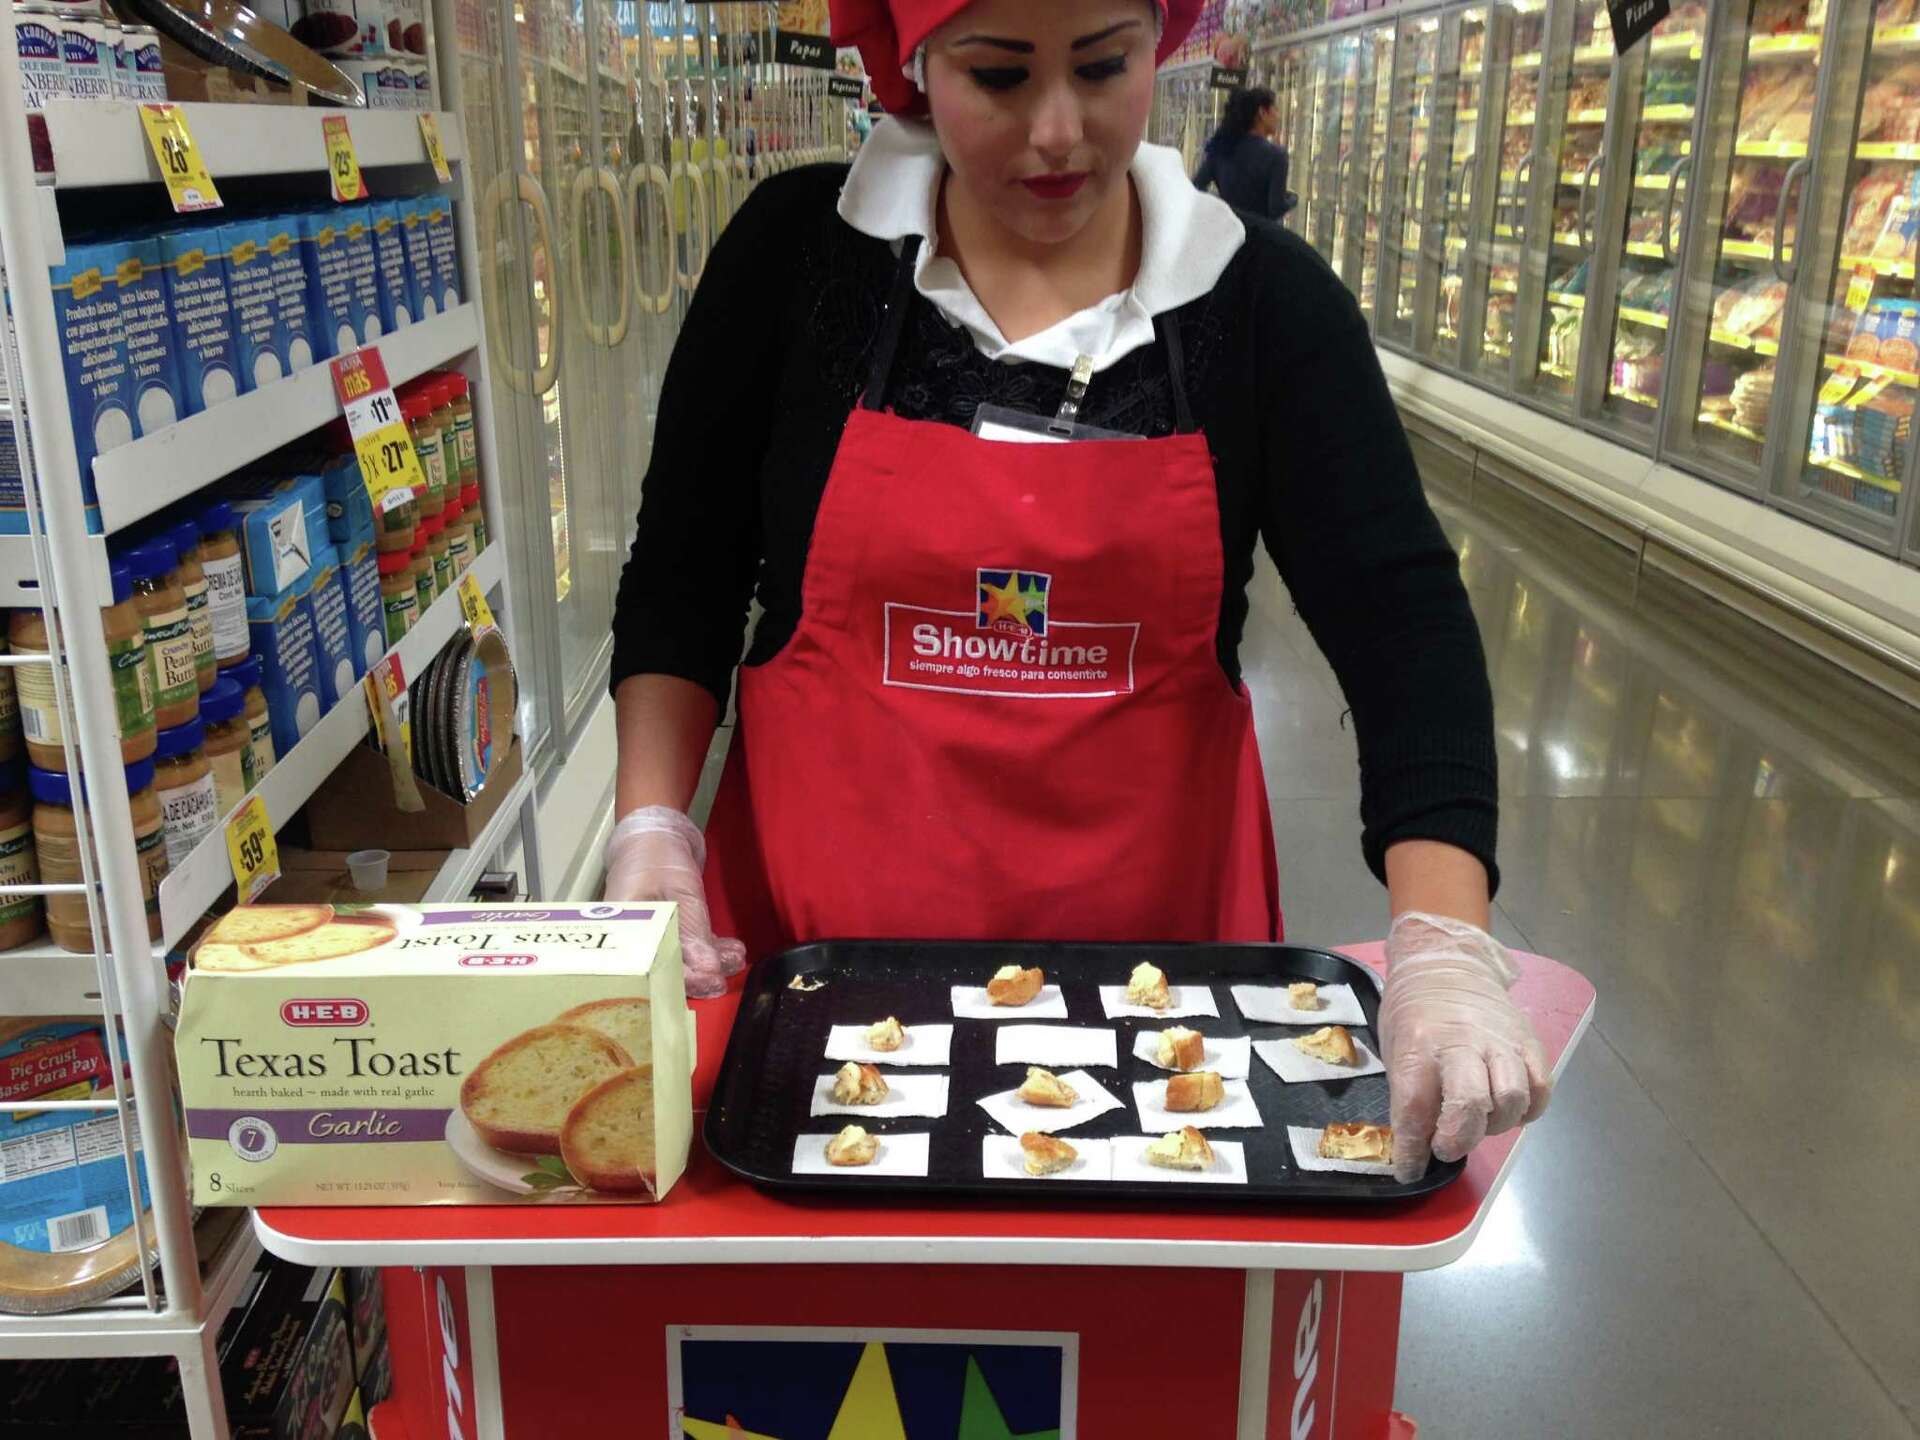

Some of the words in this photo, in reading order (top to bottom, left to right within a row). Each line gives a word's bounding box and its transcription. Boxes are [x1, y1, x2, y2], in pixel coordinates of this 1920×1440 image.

[789, 40, 822, 60] Papas
[22, 74, 66, 90] NBERR
[69, 78, 109, 94] BERRY
[912, 623, 1109, 667] Showtime
[909, 659, 954, 675] siempre
[957, 664, 980, 678] algo
[983, 665, 1018, 679] fresco
[1021, 669, 1044, 681] para
[1047, 669, 1108, 681] consentirte
[400, 933, 500, 950] Toast
[513, 933, 616, 950] Texas
[291, 1004, 359, 1019] H-E-B
[10, 1063, 33, 1080] Pie
[38, 1048, 78, 1070] Crust
[200, 1037, 328, 1078] Texas
[332, 1037, 463, 1078] Toast
[35, 1068, 67, 1087] Para
[71, 1056, 98, 1074] Pay
[232, 1086, 267, 1097] hearth
[270, 1086, 303, 1097] baked
[320, 1086, 349, 1096] made
[353, 1086, 377, 1097] with
[381, 1086, 401, 1096] real
[404, 1086, 435, 1099] garlic
[308, 1110, 403, 1138] Garlic
[247, 1130, 257, 1148] 7
[210, 1172, 221, 1192] 8
[225, 1183, 256, 1194] Slices
